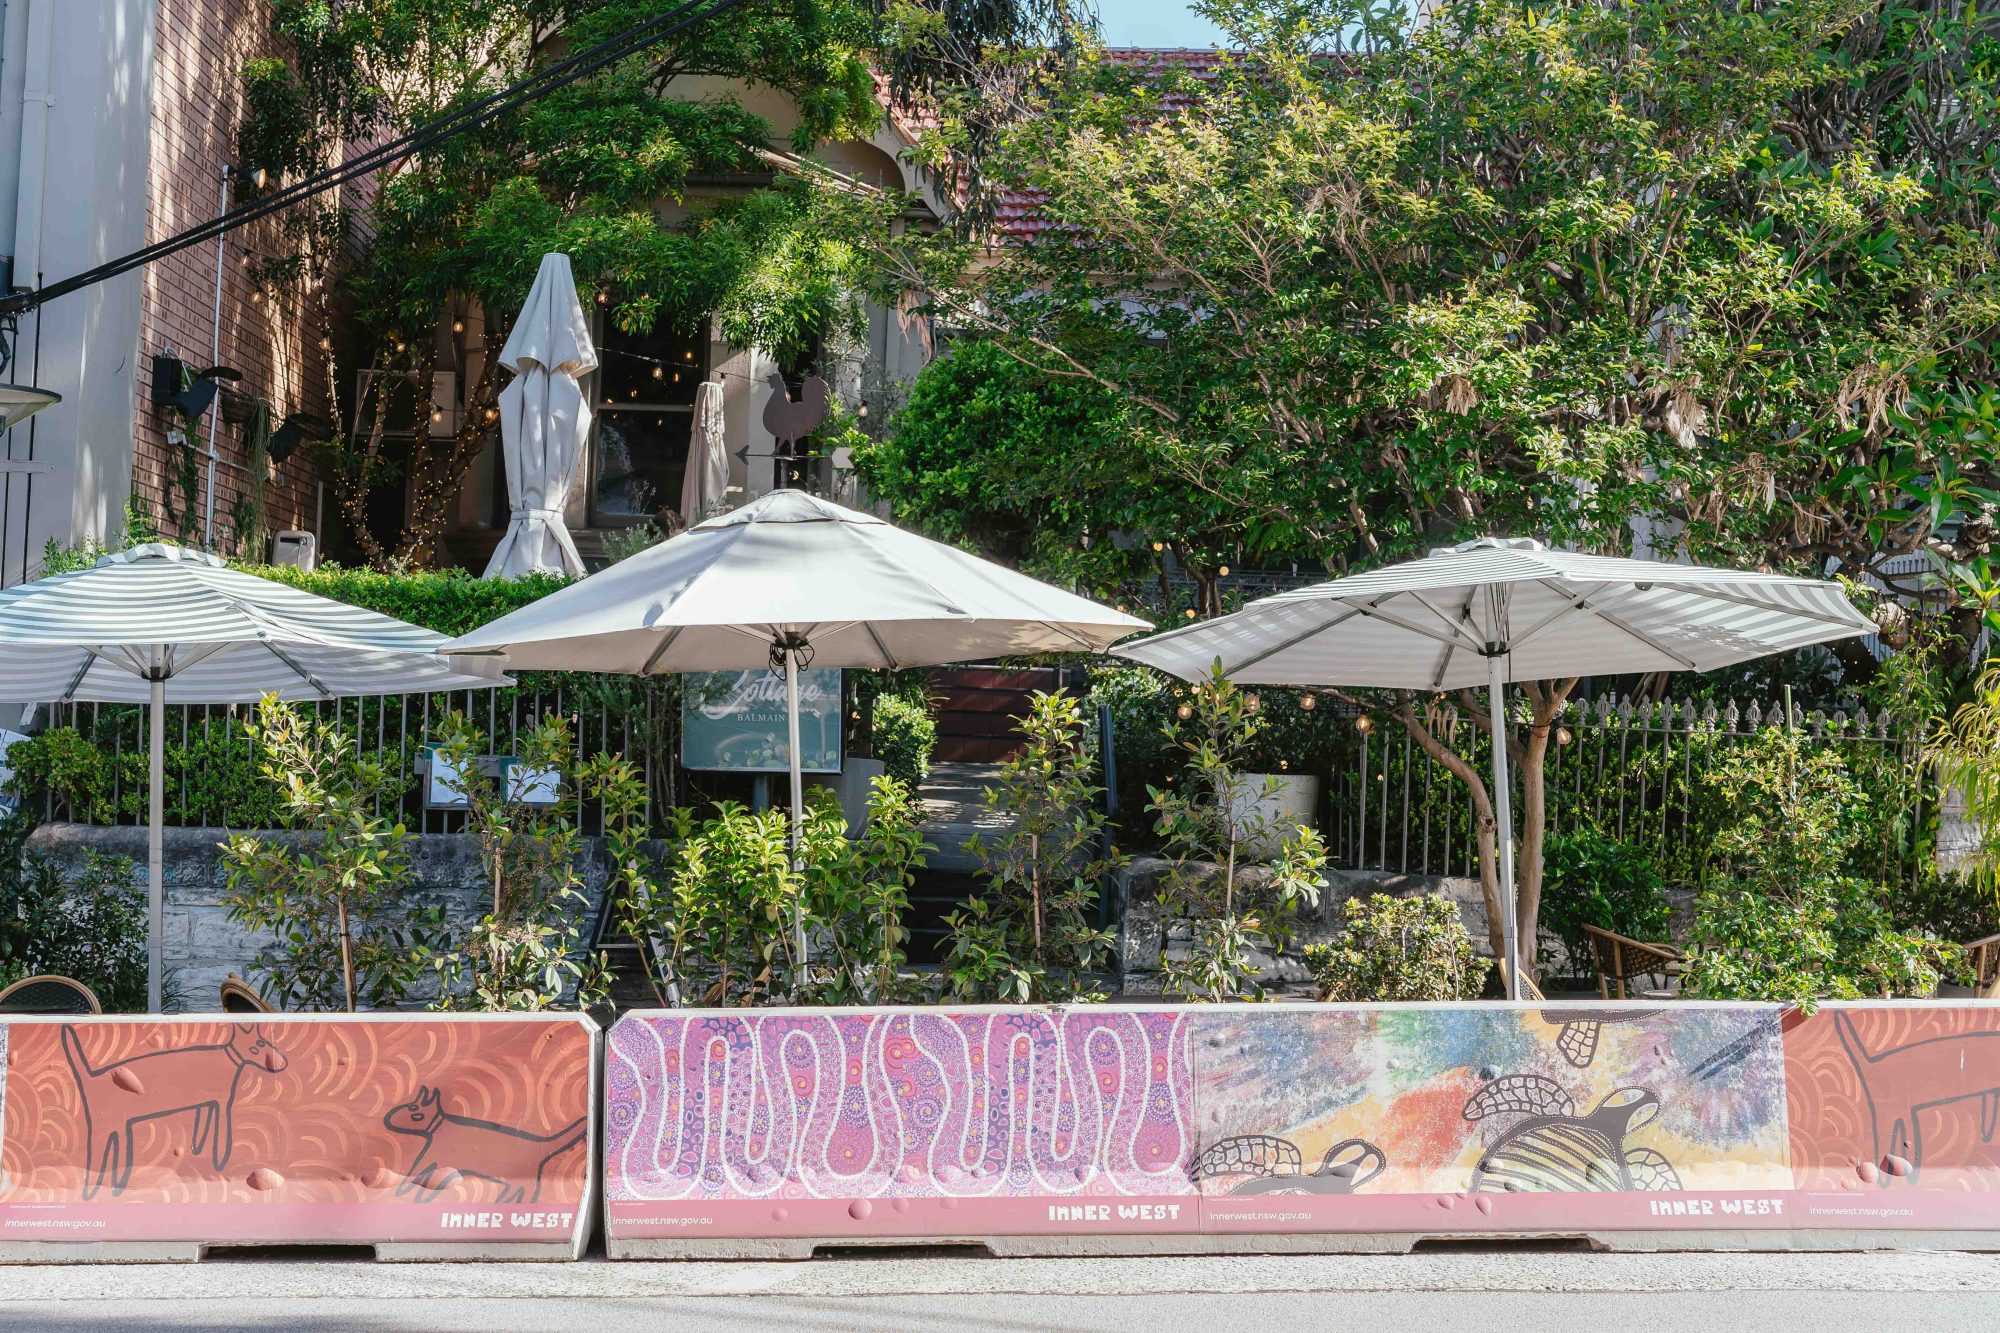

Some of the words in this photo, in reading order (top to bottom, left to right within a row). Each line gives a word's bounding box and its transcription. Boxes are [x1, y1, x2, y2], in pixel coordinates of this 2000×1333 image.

[737, 713, 785, 722] BALMAIN
[1118, 1204, 1180, 1220] WEST
[1720, 1199, 1784, 1215] WEST
[1809, 1206, 1914, 1217] innerwest.nsw.gov.au
[511, 1212, 573, 1228] WEST
[612, 1216, 713, 1227] innerwest.nsw.gov.au
[1210, 1212, 1311, 1221] innerwest.nsw.gov.au
[5, 1219, 106, 1229] innerwest.nsw.gov.au
